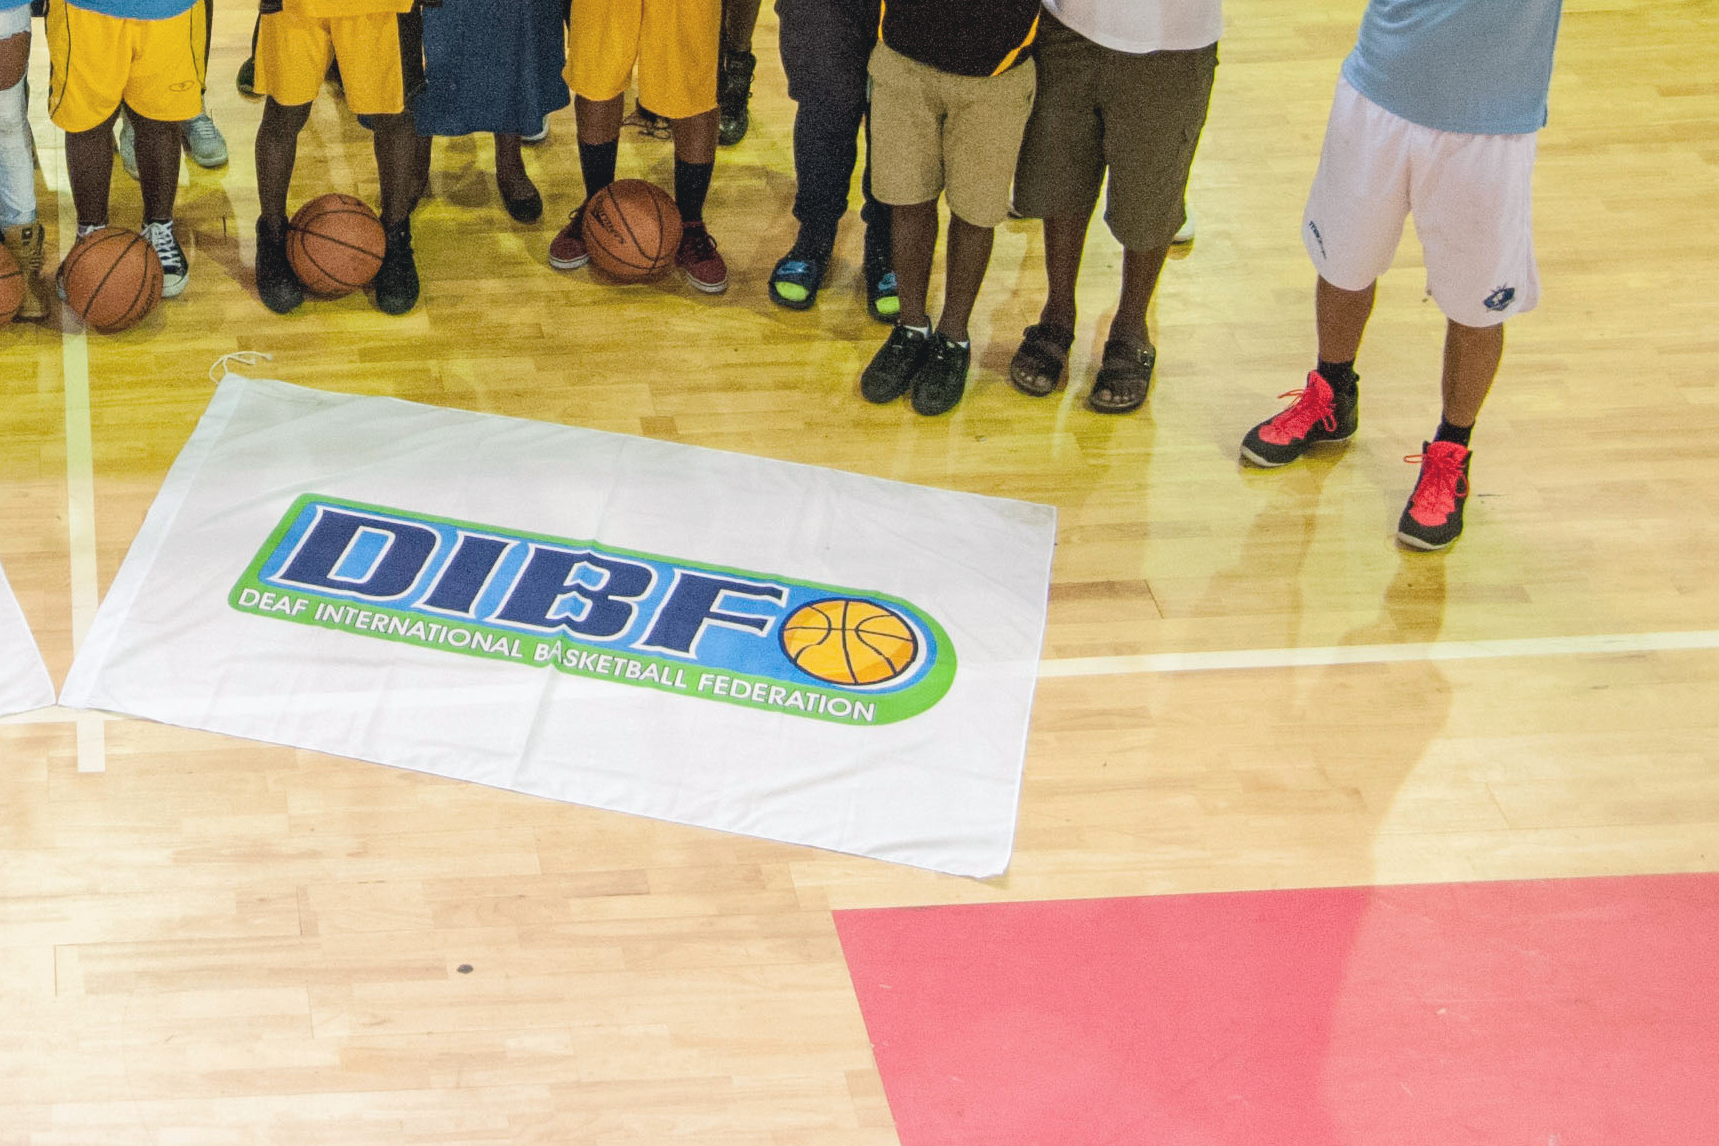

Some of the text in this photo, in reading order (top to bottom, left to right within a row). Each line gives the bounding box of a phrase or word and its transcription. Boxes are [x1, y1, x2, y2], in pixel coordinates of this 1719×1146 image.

[237, 586, 876, 724] DEAF INTERNATIONAL BASKETBALL FEDERATION
[267, 504, 789, 660] DIBF
